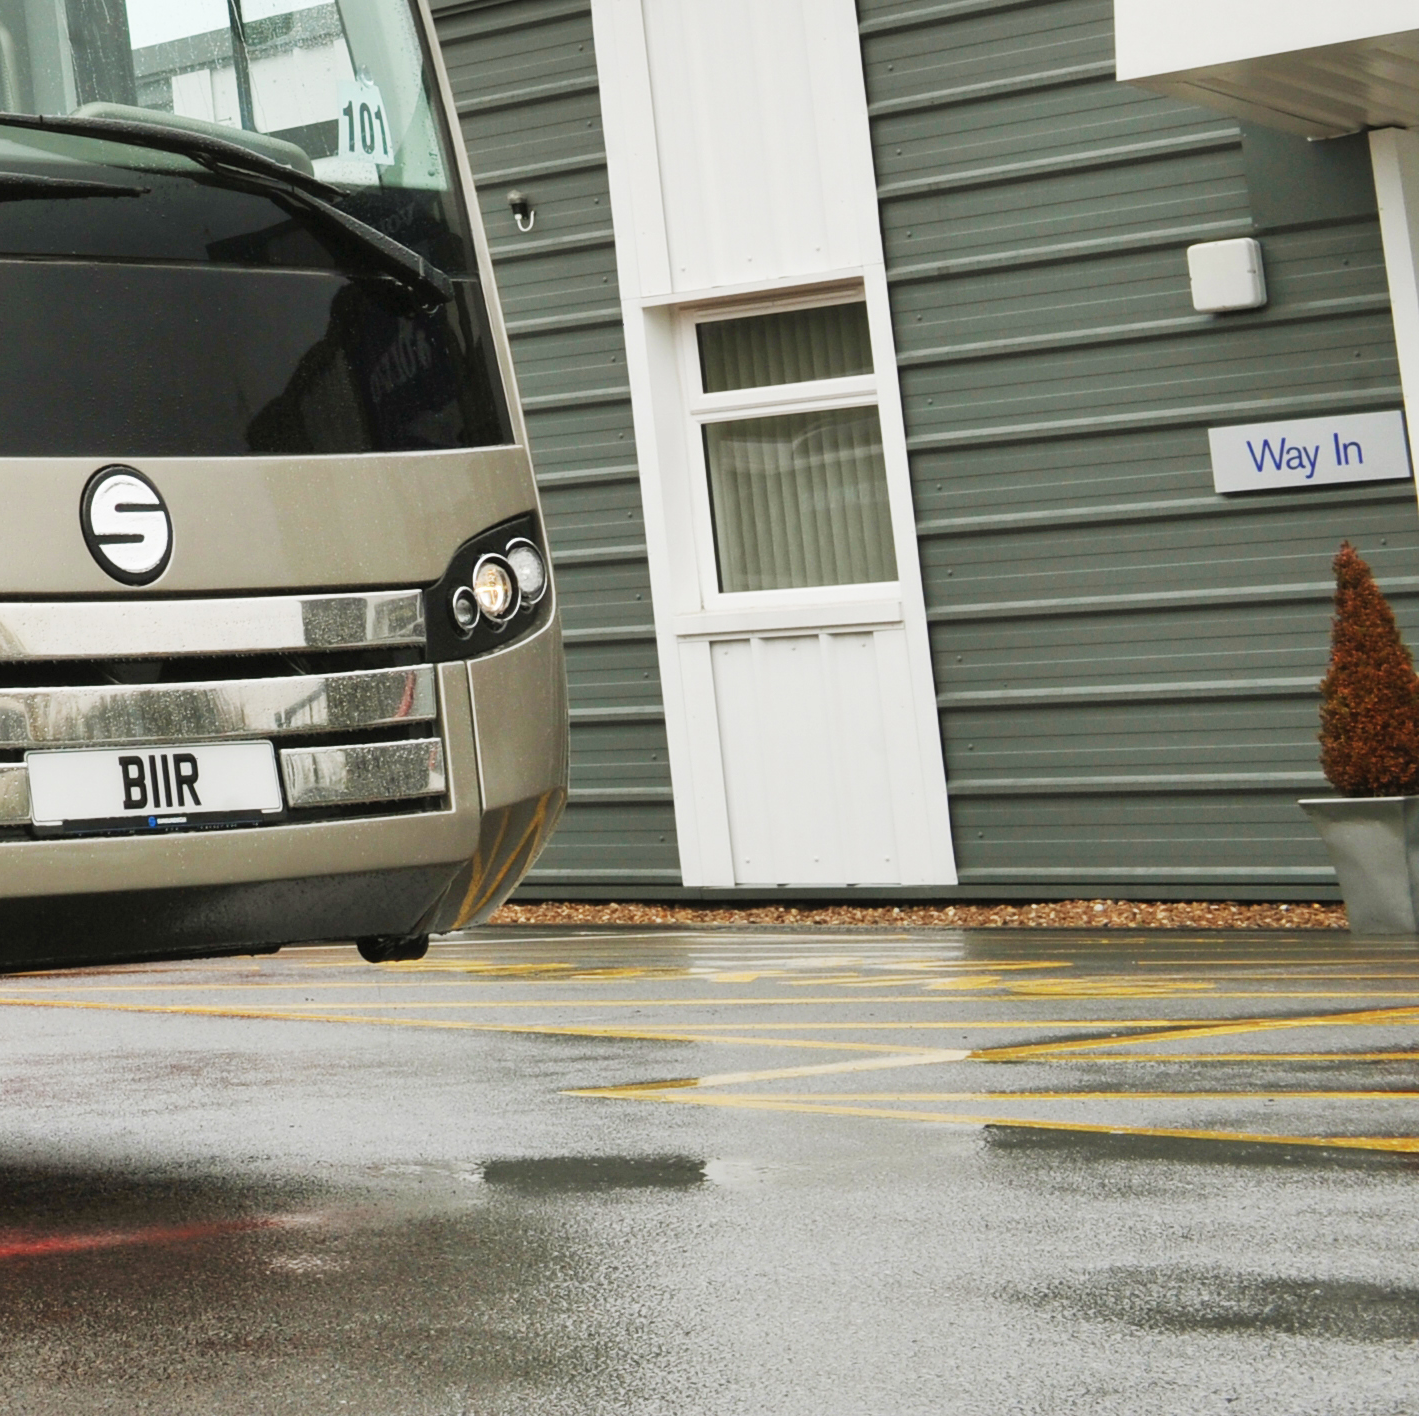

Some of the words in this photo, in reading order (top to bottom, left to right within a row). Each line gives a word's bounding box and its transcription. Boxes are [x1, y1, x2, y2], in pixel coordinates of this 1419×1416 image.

[343, 100, 389, 156] 101
[1246, 437, 1320, 479] Way
[1333, 432, 1363, 466] In
